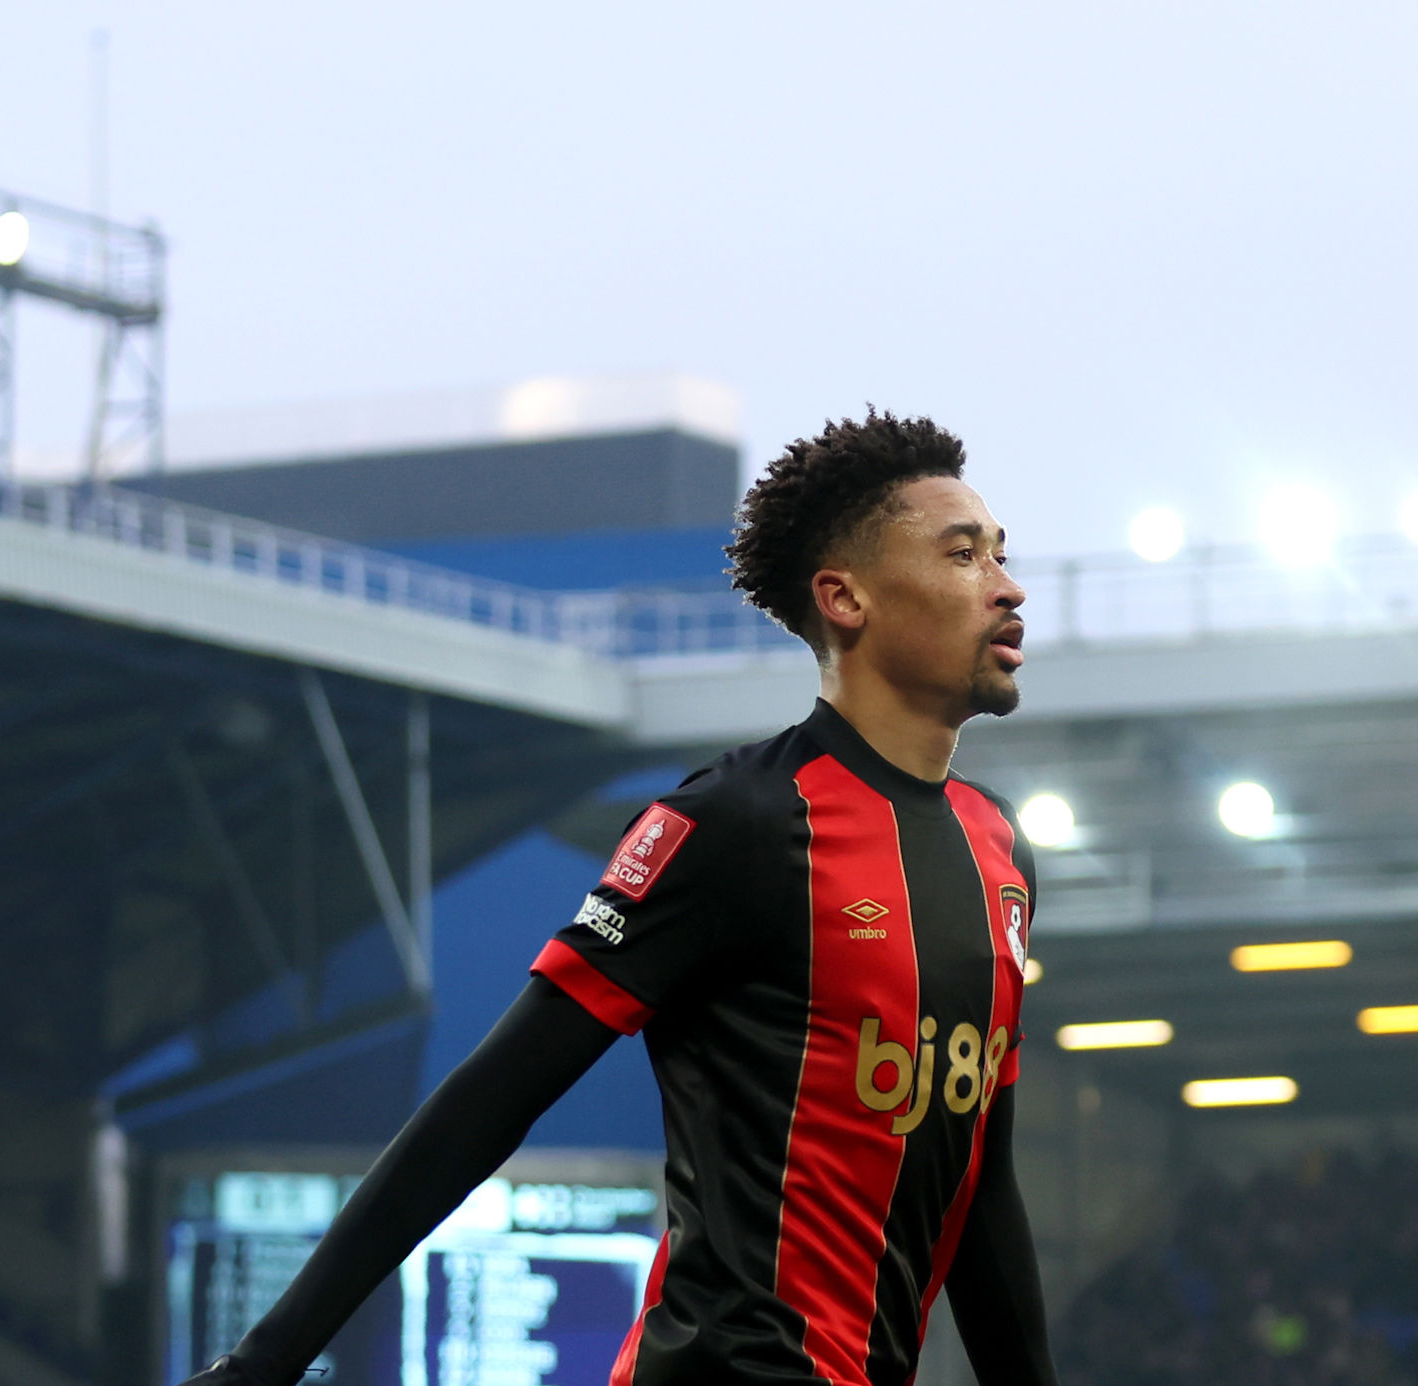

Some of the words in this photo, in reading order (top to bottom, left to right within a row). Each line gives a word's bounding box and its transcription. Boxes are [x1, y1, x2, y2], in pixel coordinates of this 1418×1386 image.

[609, 862, 621, 875] FA
[620, 866, 645, 886] CUP
[616, 851, 651, 876] Emirates
[848, 926, 887, 939] umbro
[855, 1015, 1008, 1135] bj88
